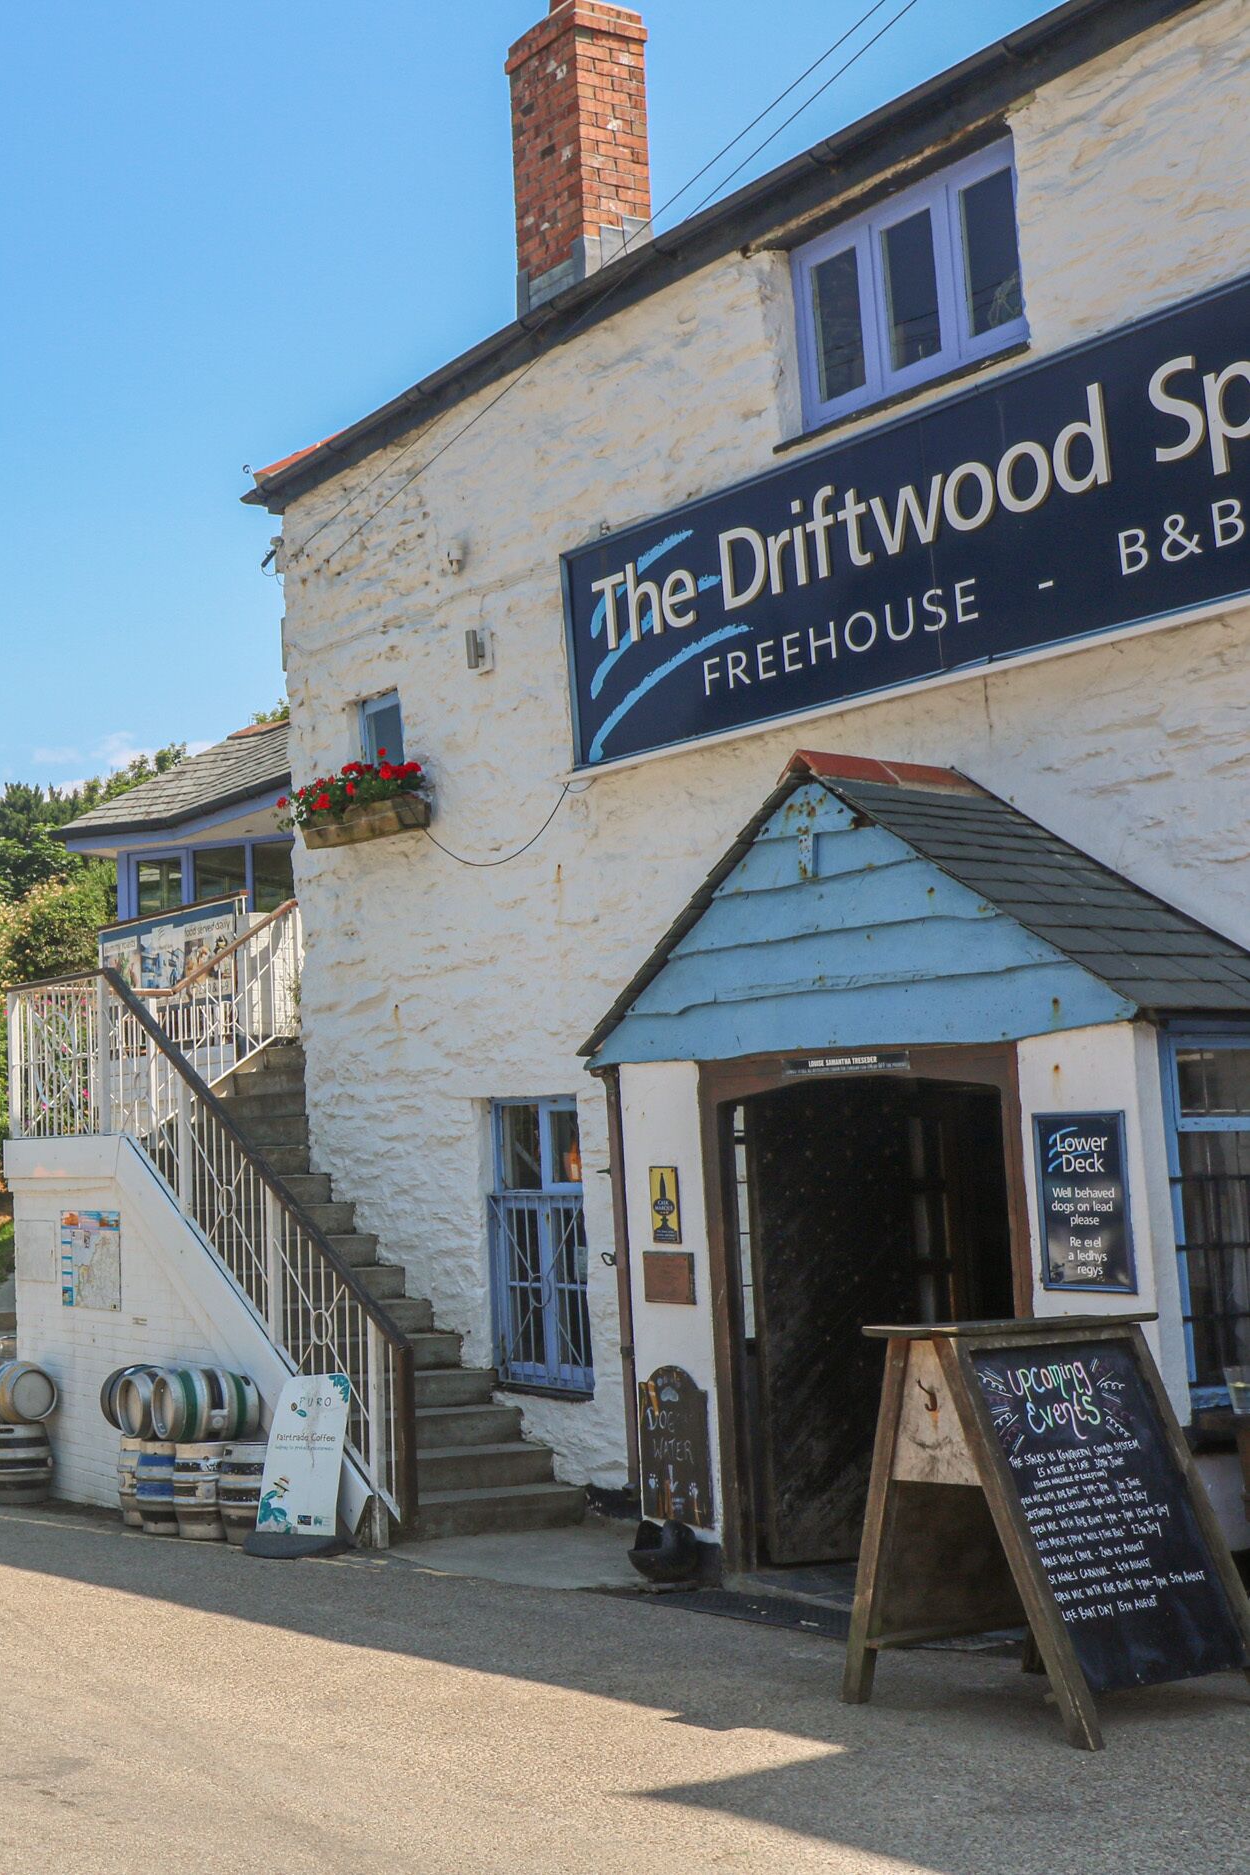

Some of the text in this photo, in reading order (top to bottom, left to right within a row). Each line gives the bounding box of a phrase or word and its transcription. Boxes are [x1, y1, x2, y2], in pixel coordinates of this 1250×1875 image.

[591, 562, 698, 650] The
[717, 381, 1112, 612] Driftwood
[703, 578, 979, 696] FREEHOUSE
[215, 919, 231, 931] daily
[825, 1057, 851, 1067] SAMANTHA
[1056, 1132, 1108, 1152] Lower
[1062, 1152, 1106, 1173] Deck
[1052, 1186, 1115, 1198] Well behaved
[1051, 1200, 1113, 1214] dogs on lead
[1070, 1213, 1100, 1228] please
[1068, 1251, 1075, 1261] a
[1077, 1265, 1103, 1278] regys
[299, 1396, 332, 1408] PURO
[276, 1431, 336, 1442] Fairtrade Coffee
[653, 1437, 694, 1465] WATER
[1009, 1456, 1023, 1469] THE
[1113, 1439, 1141, 1453] SYSTEM
[1030, 1523, 1047, 1538] OPEN
[1144, 1520, 1162, 1537] JULY
[1041, 1556, 1058, 1568] MALE
[1057, 1553, 1075, 1566] VOICE
[1123, 1540, 1144, 1554] AUGUST
[1048, 1574, 1058, 1585] ST
[1079, 1566, 1110, 1579] CARNIVAL
[1129, 1557, 1152, 1570] AUGUST
[1054, 1590, 1071, 1604] OPEN
[1085, 1584, 1102, 1596] WITH
[1182, 1570, 1205, 1582] AUGUST
[1061, 1608, 1078, 1623] LIFE
[1097, 1603, 1114, 1616] DAY
[1134, 1594, 1158, 1610] AUGUST
